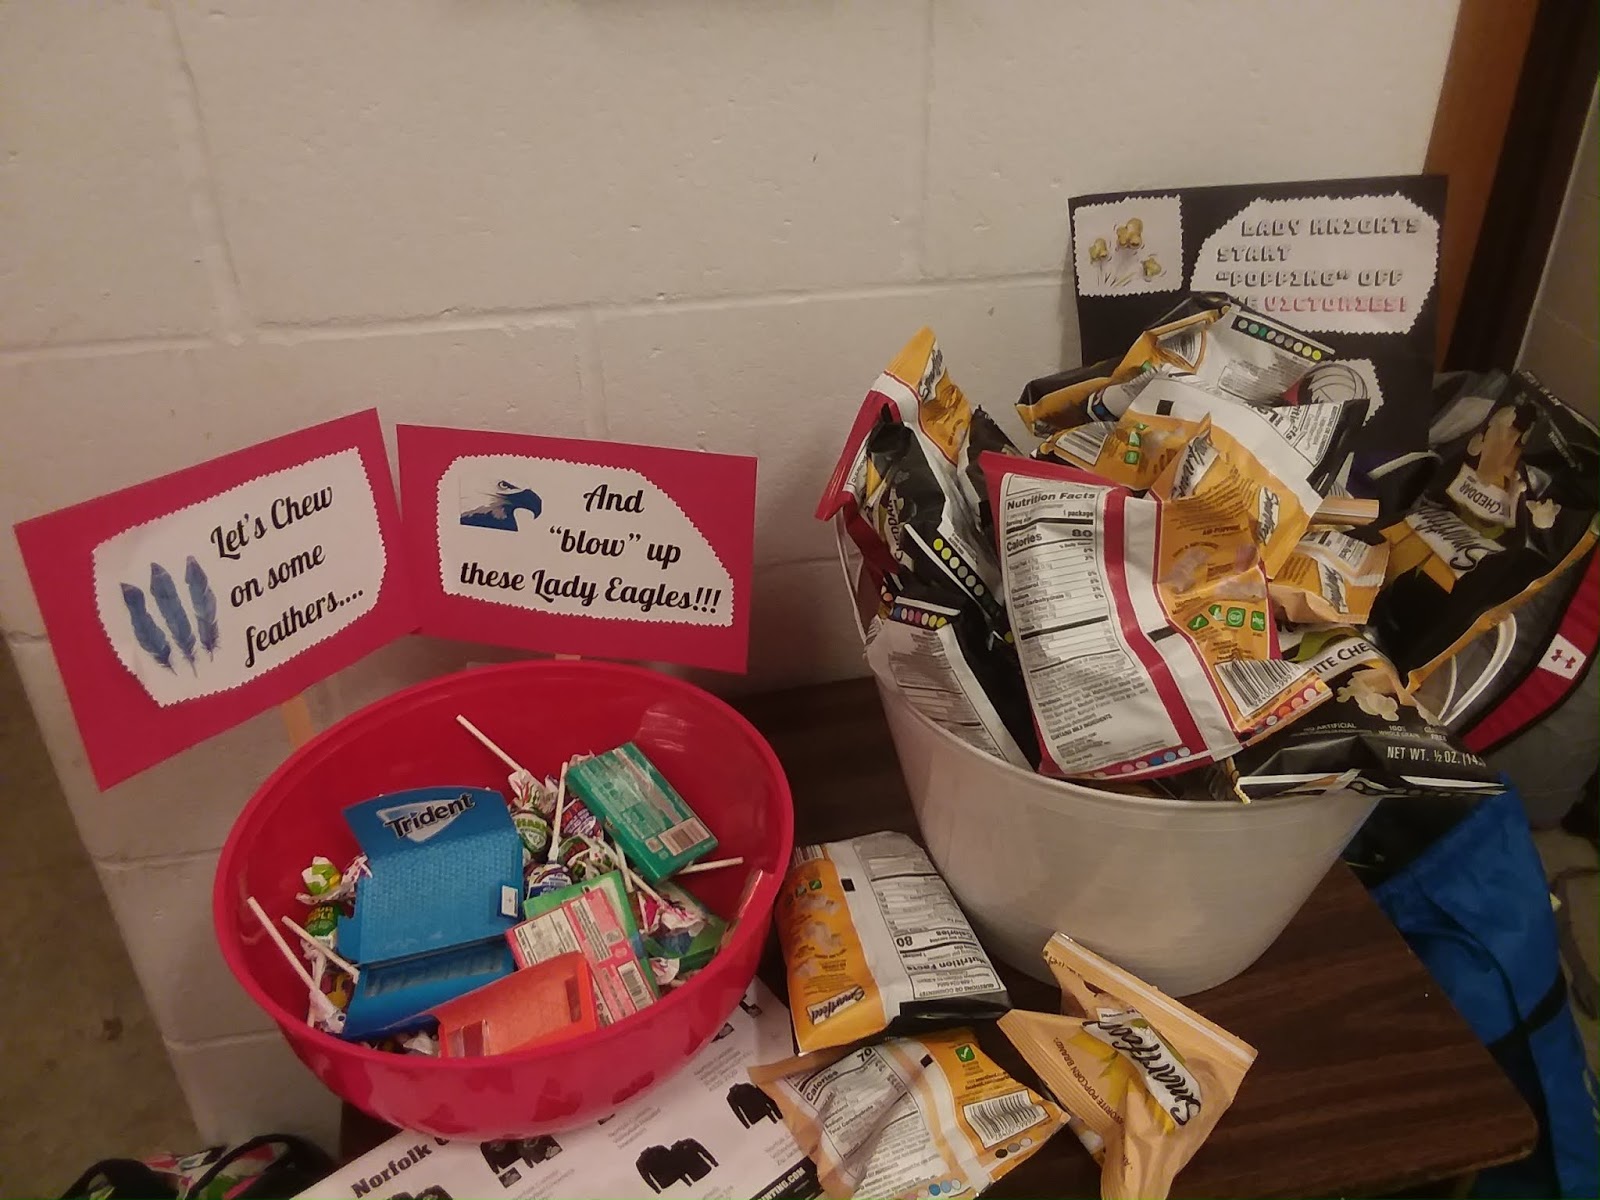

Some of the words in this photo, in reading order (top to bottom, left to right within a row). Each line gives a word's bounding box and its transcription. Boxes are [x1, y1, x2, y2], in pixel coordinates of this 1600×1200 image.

[1241, 219, 1302, 237] LADY
[1310, 217, 1421, 234] KNIGHTS
[1217, 244, 1292, 262] START
[1358, 270, 1403, 287] OFF
[1264, 296, 1408, 313] VICTORIES!
[270, 484, 335, 527] Chew
[583, 483, 645, 515] And
[1006, 491, 1057, 511] Nutrition
[1059, 491, 1096, 501] Facts
[1459, 482, 1501, 514] CHEDDAR
[1067, 509, 1094, 518] package
[1006, 532, 1043, 552] Calories
[1071, 529, 1093, 537] 80
[647, 541, 681, 568] up
[230, 579, 263, 608] on
[267, 542, 326, 593] some
[460, 561, 525, 594] these
[531, 567, 599, 606] Lady
[604, 574, 722, 615] Eagles!!!
[1309, 656, 1338, 675] ITE
[1338, 641, 1371, 663] CHE
[1316, 722, 1357, 731] ARTIFICIAL
[1387, 746, 1406, 760] NET
[1409, 748, 1429, 762] WT.
[1443, 752, 1461, 764] OZ.
[384, 791, 476, 839] Trident
[896, 936, 914, 948] 80
[906, 964, 937, 972] Facts
[939, 956, 987, 969] Nutrition
[857, 1047, 873, 1062] 70
[1072, 1067, 1101, 1099] POPCORN
[1081, 1020, 1202, 1127] Smartfood
[806, 1070, 839, 1101] Calories
[1099, 1096, 1125, 1126] AVORITE
[351, 1144, 433, 1199] Norfolk
